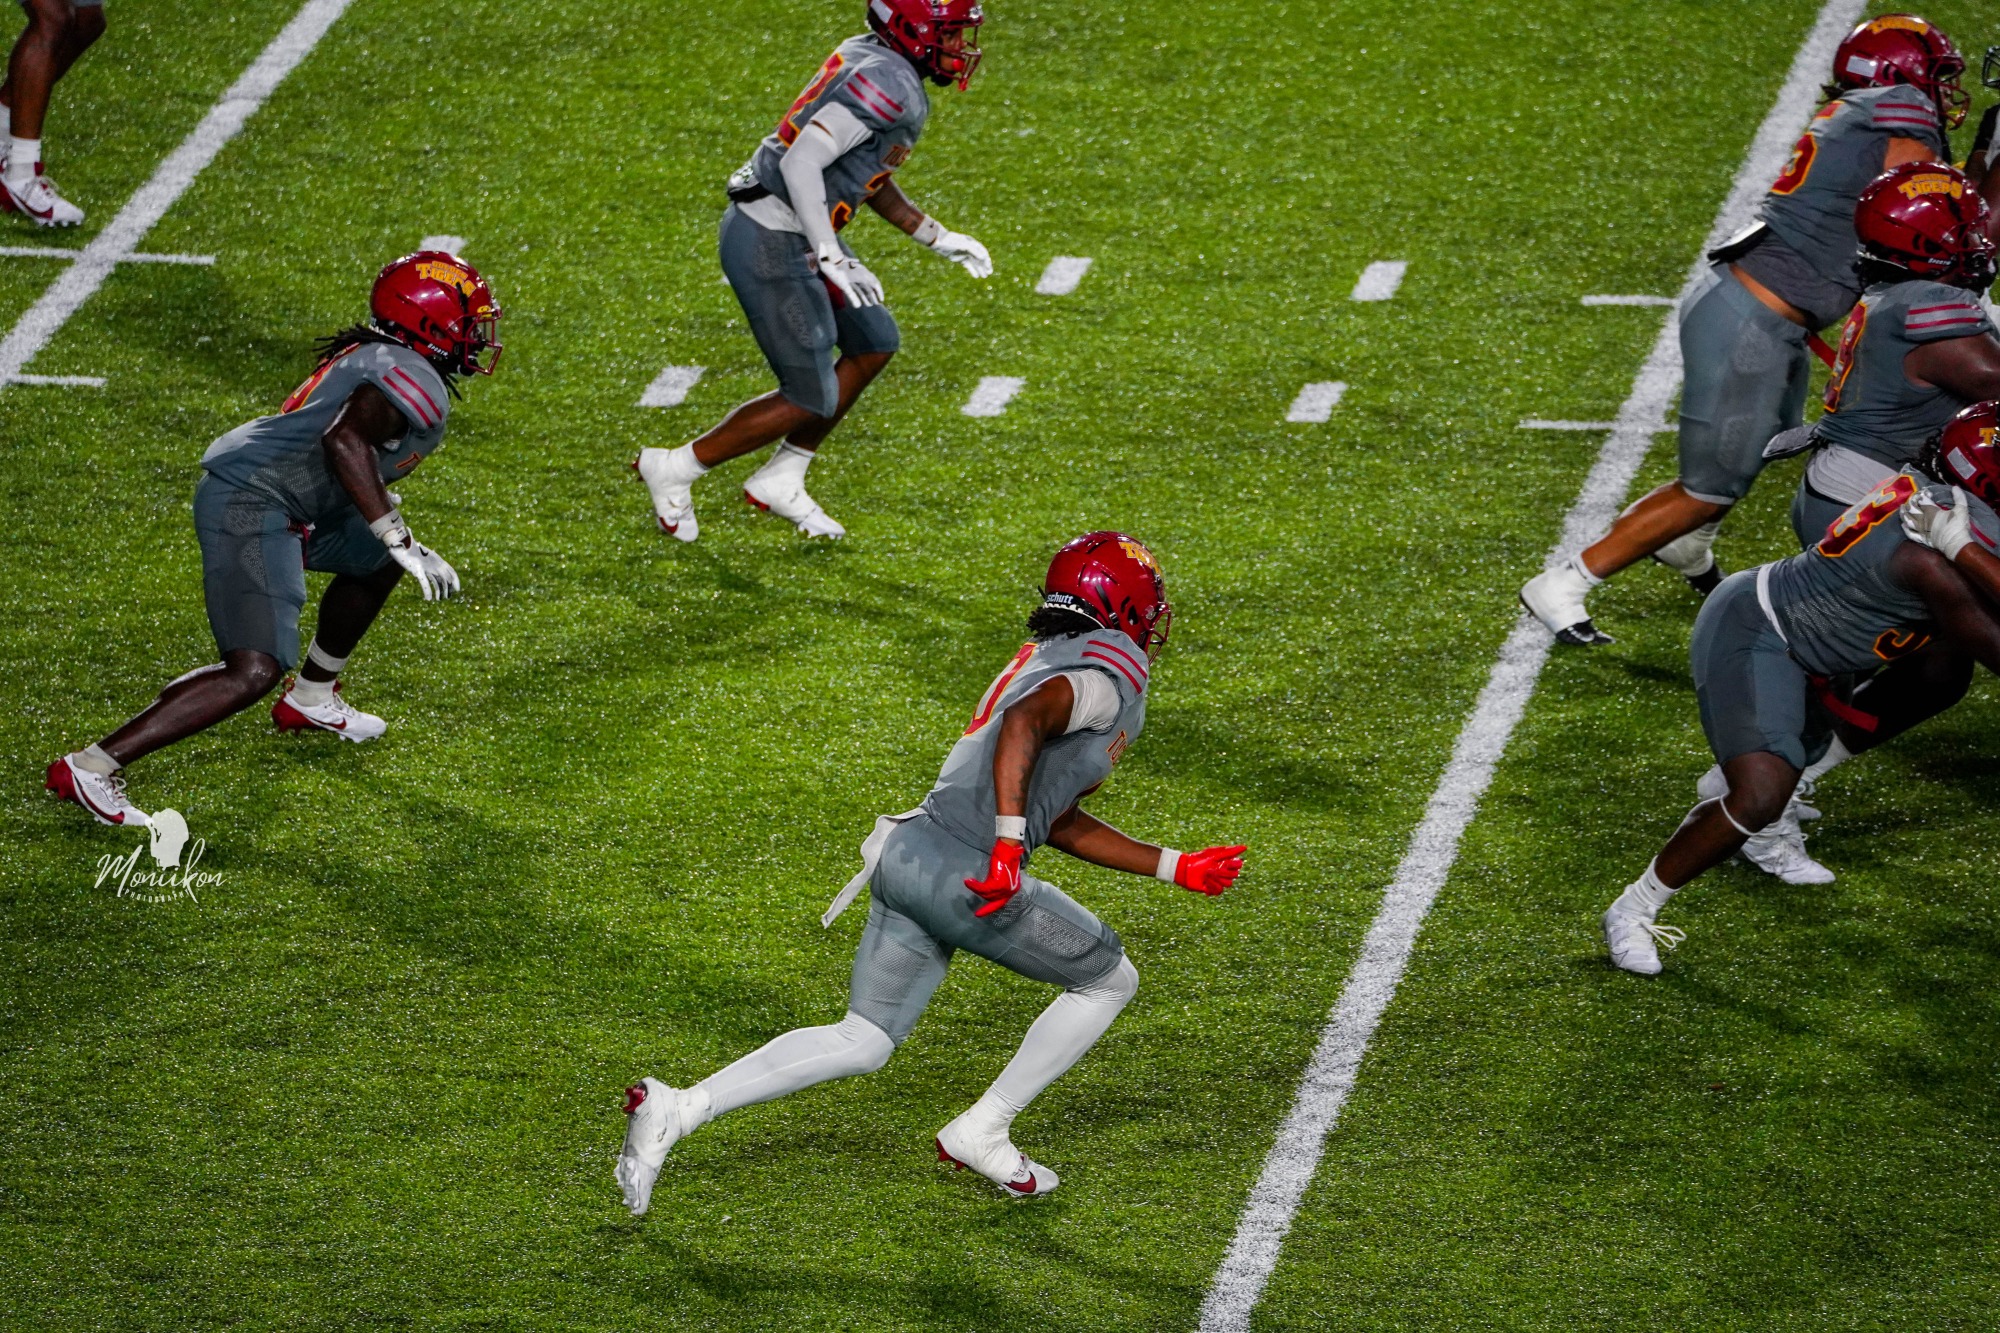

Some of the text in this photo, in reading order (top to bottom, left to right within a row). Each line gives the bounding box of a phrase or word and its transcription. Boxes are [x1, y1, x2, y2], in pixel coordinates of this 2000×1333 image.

[1898, 180, 1963, 200] TIGERS
[416, 263, 477, 298] TIGERS
[1046, 592, 1074, 604] schutt
